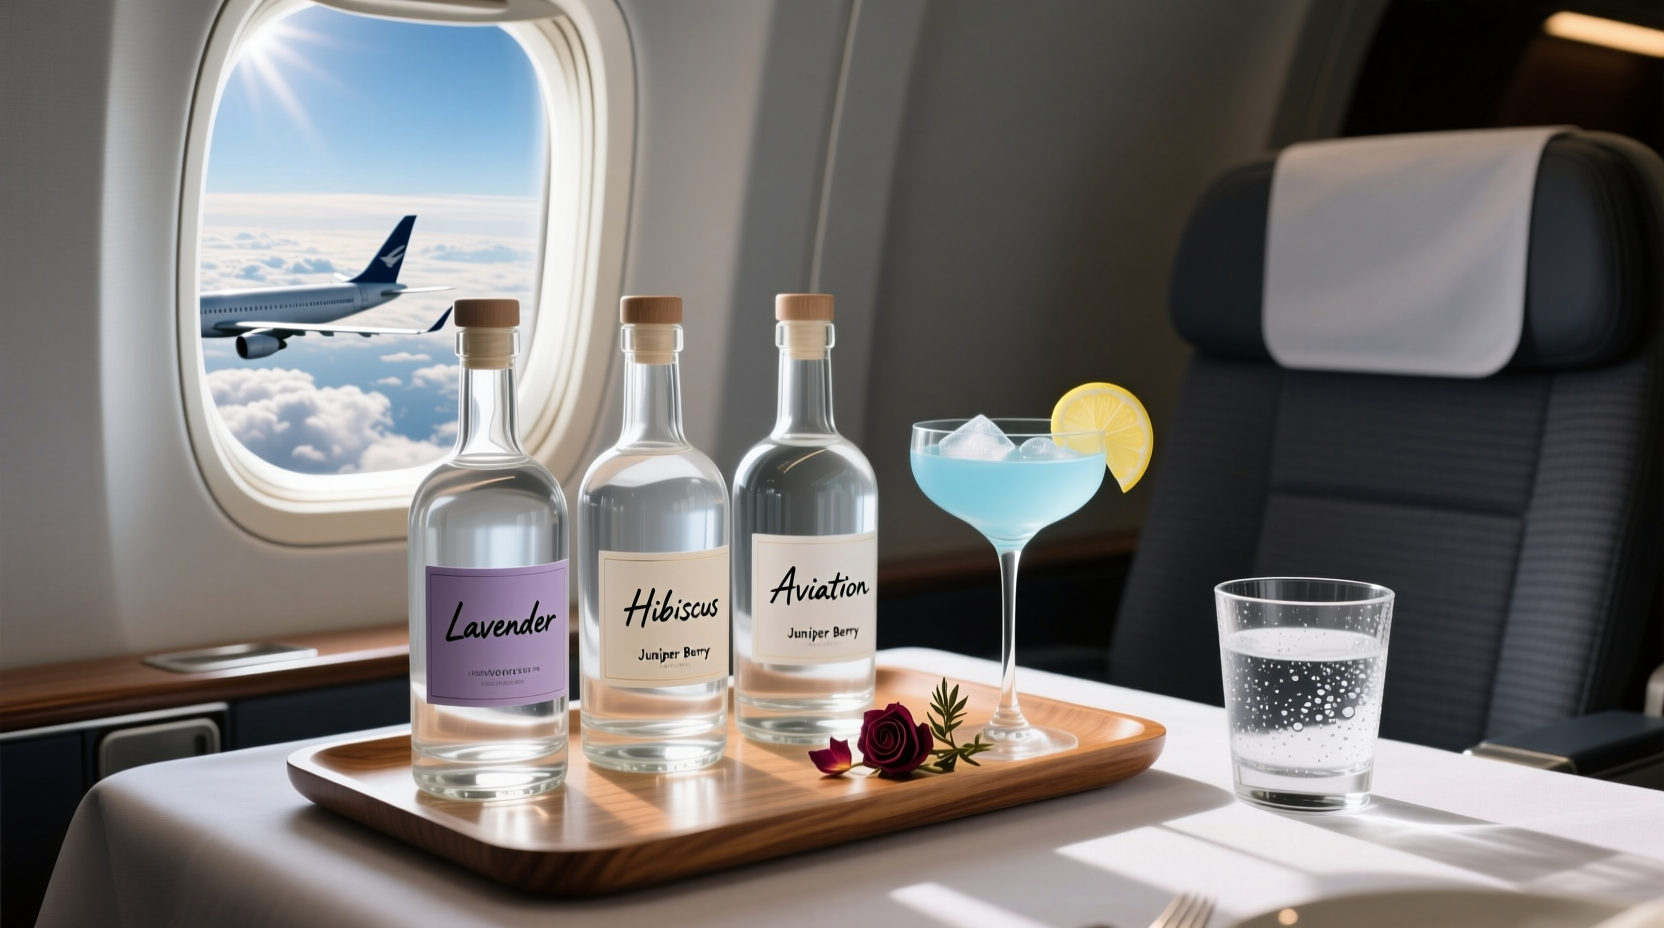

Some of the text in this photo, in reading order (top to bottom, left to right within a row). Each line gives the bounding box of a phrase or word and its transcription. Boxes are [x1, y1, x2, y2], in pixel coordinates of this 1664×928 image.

[769, 565, 870, 606] Aviation
[444, 600, 557, 643] Lavender
[623, 587, 719, 629] Hibiscus
[787, 625, 860, 643] Juniper Berry
[638, 647, 680, 664] Juniper
